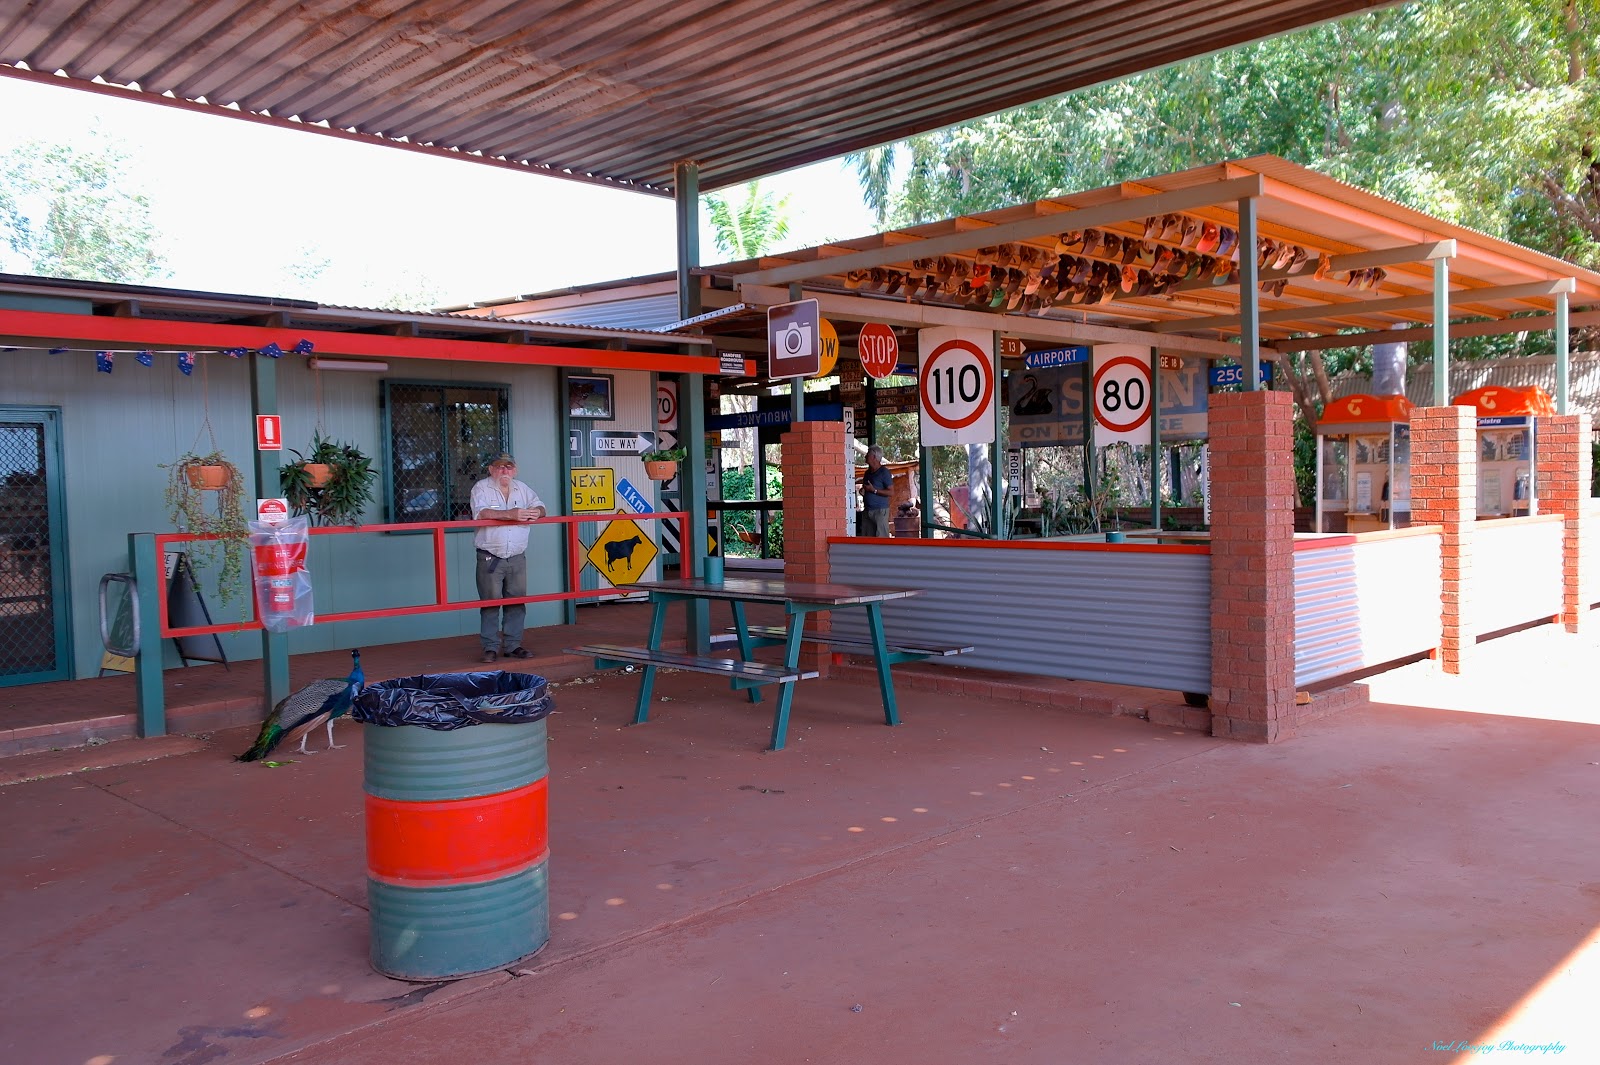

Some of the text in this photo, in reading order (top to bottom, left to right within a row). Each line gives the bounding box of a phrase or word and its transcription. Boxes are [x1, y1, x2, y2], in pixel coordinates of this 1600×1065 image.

[861, 333, 895, 364] STOP
[1008, 341, 1016, 352] 13
[1033, 349, 1078, 365] AIRPORT
[1160, 356, 1169, 368] GE
[932, 364, 982, 405] 110
[1102, 377, 1145, 412] 80
[846, 422, 852, 434] 2
[1020, 426, 1051, 438] ON
[598, 439, 637, 449] ONE WAY
[1010, 455, 1019, 481] ROBE
[571, 475, 606, 487] NEXT
[590, 495, 606, 504] km
[624, 487, 646, 513] 1km
[275, 549, 292, 558] FIRE
